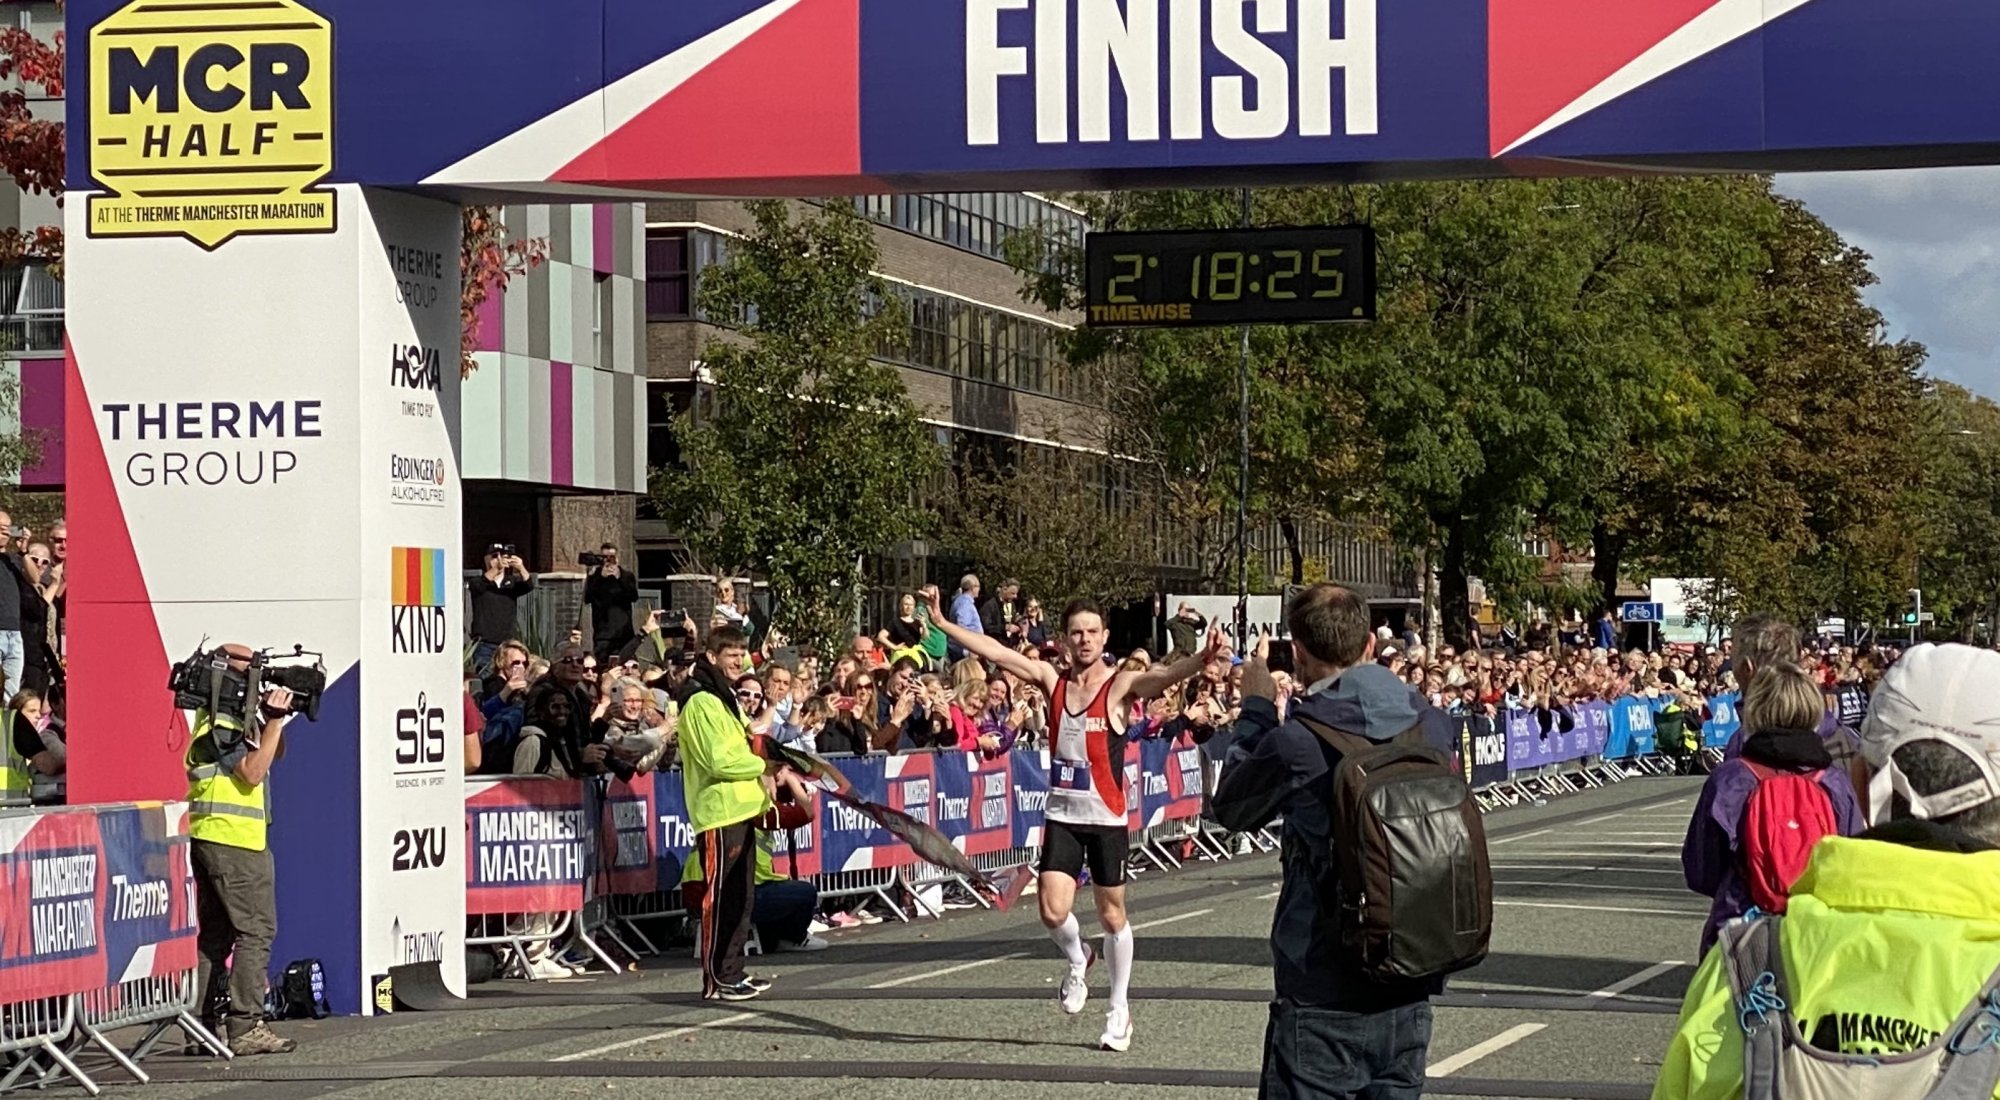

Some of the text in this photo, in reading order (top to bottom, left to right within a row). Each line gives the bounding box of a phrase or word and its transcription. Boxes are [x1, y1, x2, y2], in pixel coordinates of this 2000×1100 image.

[108, 43, 312, 115] MCR
[966, 0, 1378, 145] FINISH
[142, 122, 278, 158] HALF
[97, 203, 325, 223] AT THE THERME MANCHESTER MARATHON
[388, 244, 442, 279] THERME
[1191, 249, 1344, 300] 18:25
[395, 279, 438, 308] GROUP
[1090, 303, 1192, 321] TIMEWISE
[391, 343, 442, 392] HOKA
[102, 400, 322, 440] THERME
[126, 450, 297, 486] GROUP
[391, 454, 434, 485] ERDINGER
[391, 485, 445, 502] ALKOHOLFREI
[391, 605, 446, 654] KIND
[396, 779, 419, 788] SCIENCE
[429, 777, 445, 786] SPORT
[1060, 766, 1074, 782] 90
[479, 810, 585, 842] MANCHEST
[660, 815, 696, 849] The
[393, 827, 446, 872] 2XU
[32, 854, 97, 899] MANCHESTER
[112, 875, 169, 922] Therme
[32, 898, 97, 955] MARATHON
[404, 930, 444, 965] TENZING
[378, 988, 393, 997] MC
